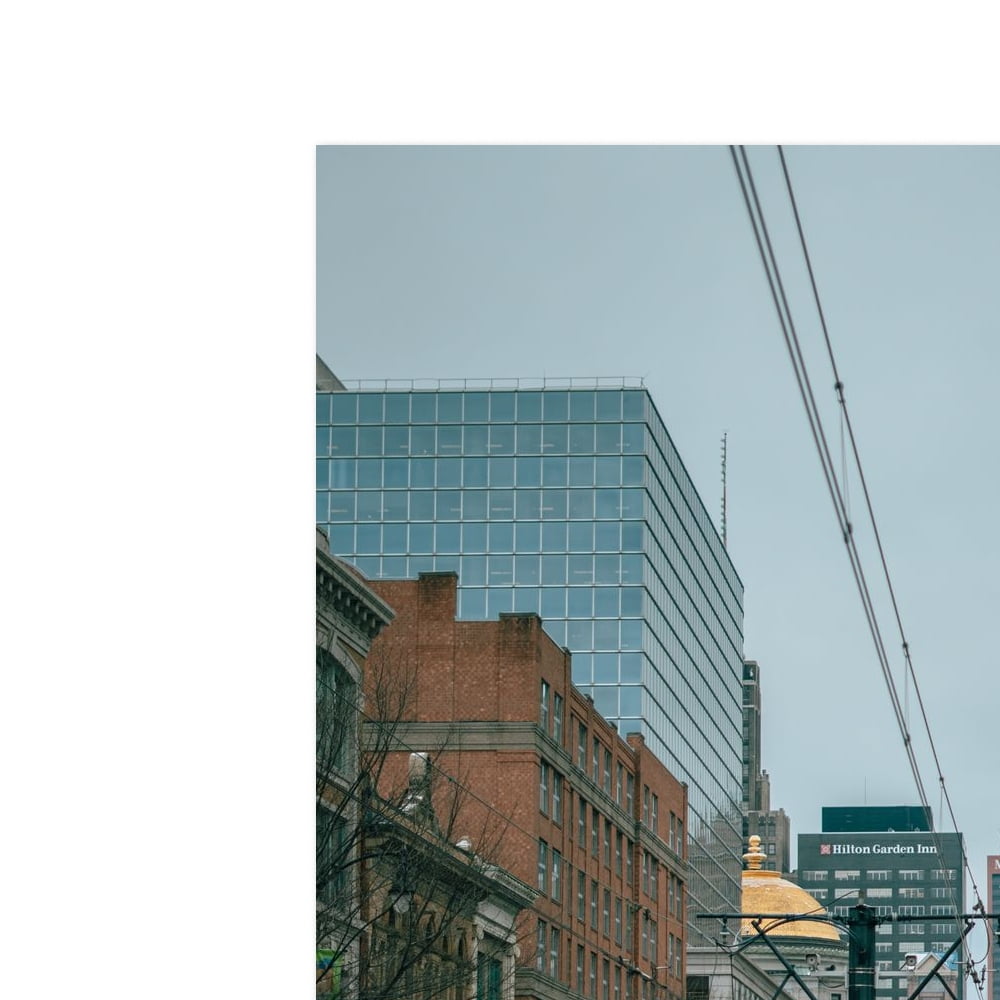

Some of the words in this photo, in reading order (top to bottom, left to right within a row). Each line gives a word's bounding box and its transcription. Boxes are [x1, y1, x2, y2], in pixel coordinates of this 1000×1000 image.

[832, 844, 870, 854] Hilton
[872, 844, 914, 854] Garden
[917, 843, 938, 854] Inn
